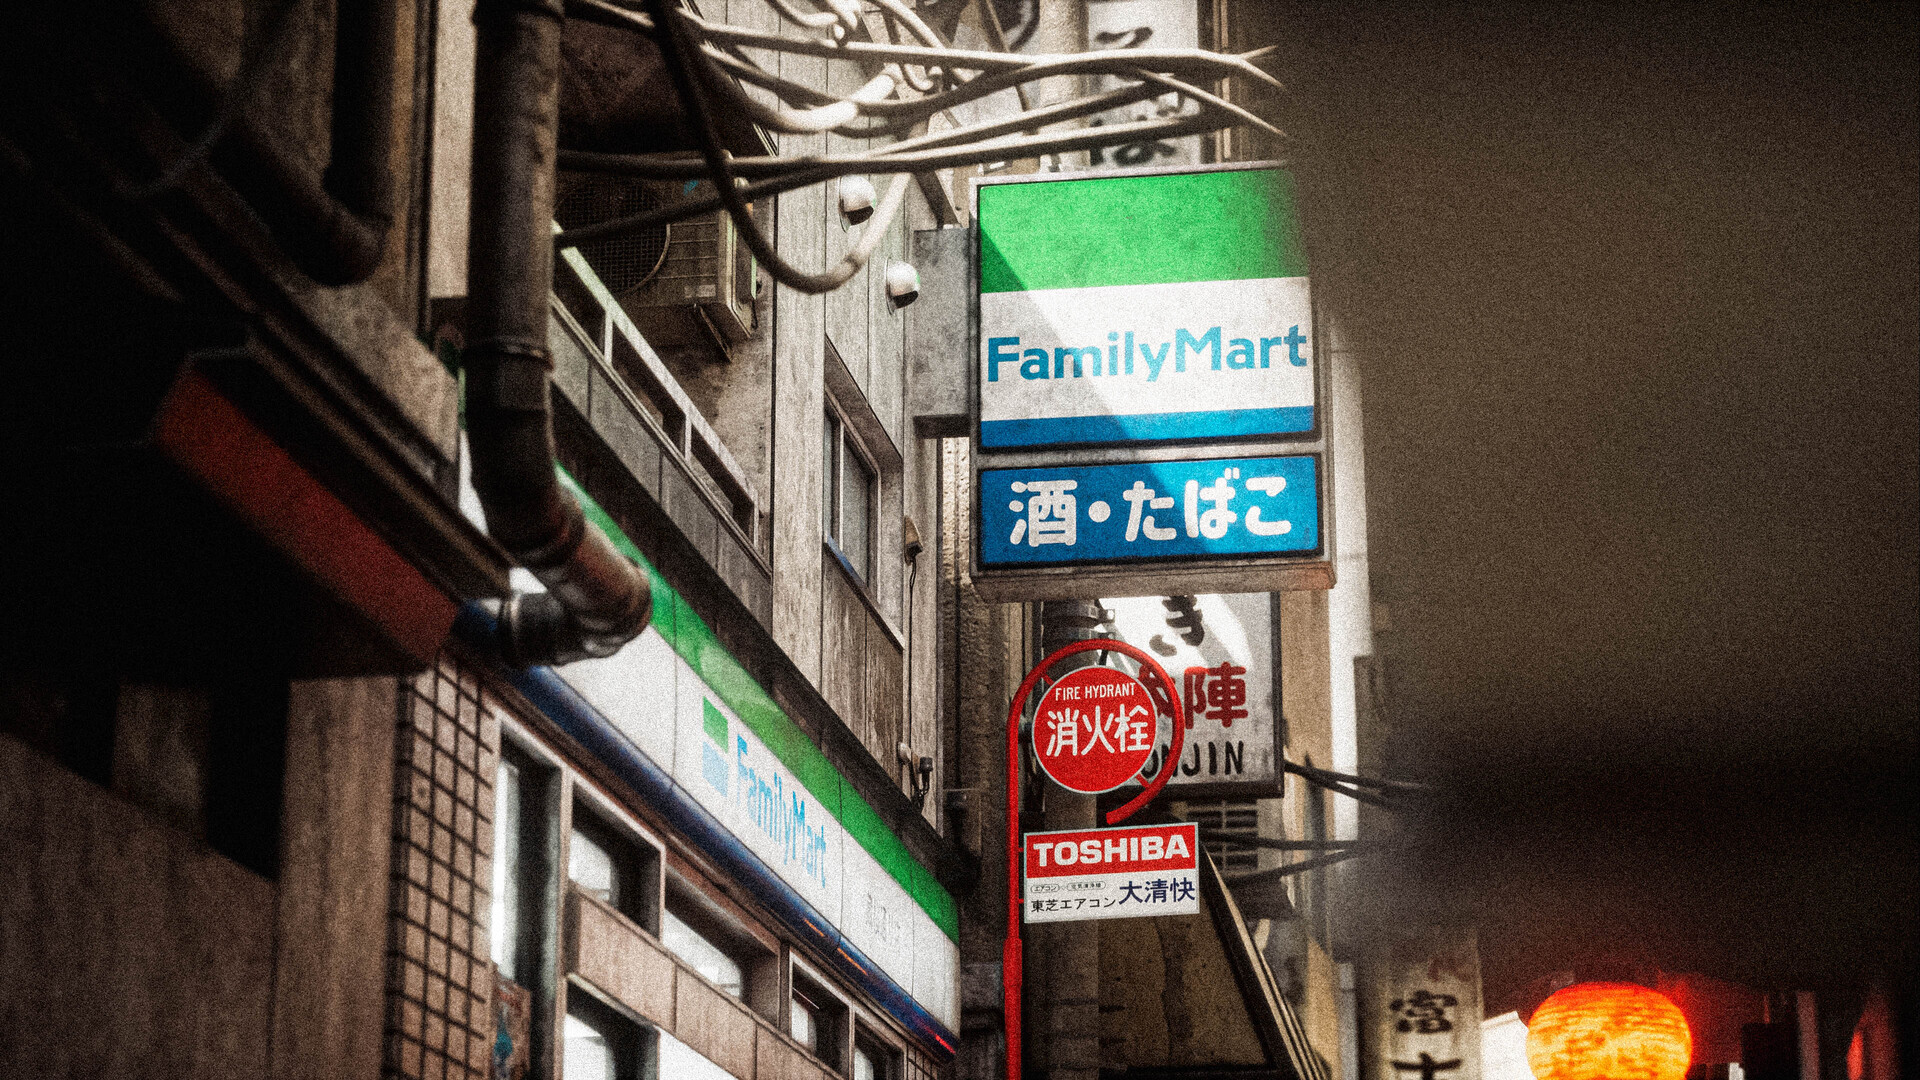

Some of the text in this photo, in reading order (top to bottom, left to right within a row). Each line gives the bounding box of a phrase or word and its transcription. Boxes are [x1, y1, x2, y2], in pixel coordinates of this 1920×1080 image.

[987, 325, 1308, 382] FamilyMart
[1009, 467, 1292, 548] 酒・たばこ
[1055, 682, 1136, 702] FIRE HYDRANT
[1046, 703, 1151, 757] 消火栓
[737, 732, 826, 889] FamilyMart
[1033, 834, 1190, 867] TOSHIBA
[1031, 897, 1116, 913] 東芝エアコン
[1118, 877, 1196, 905] 大清快
